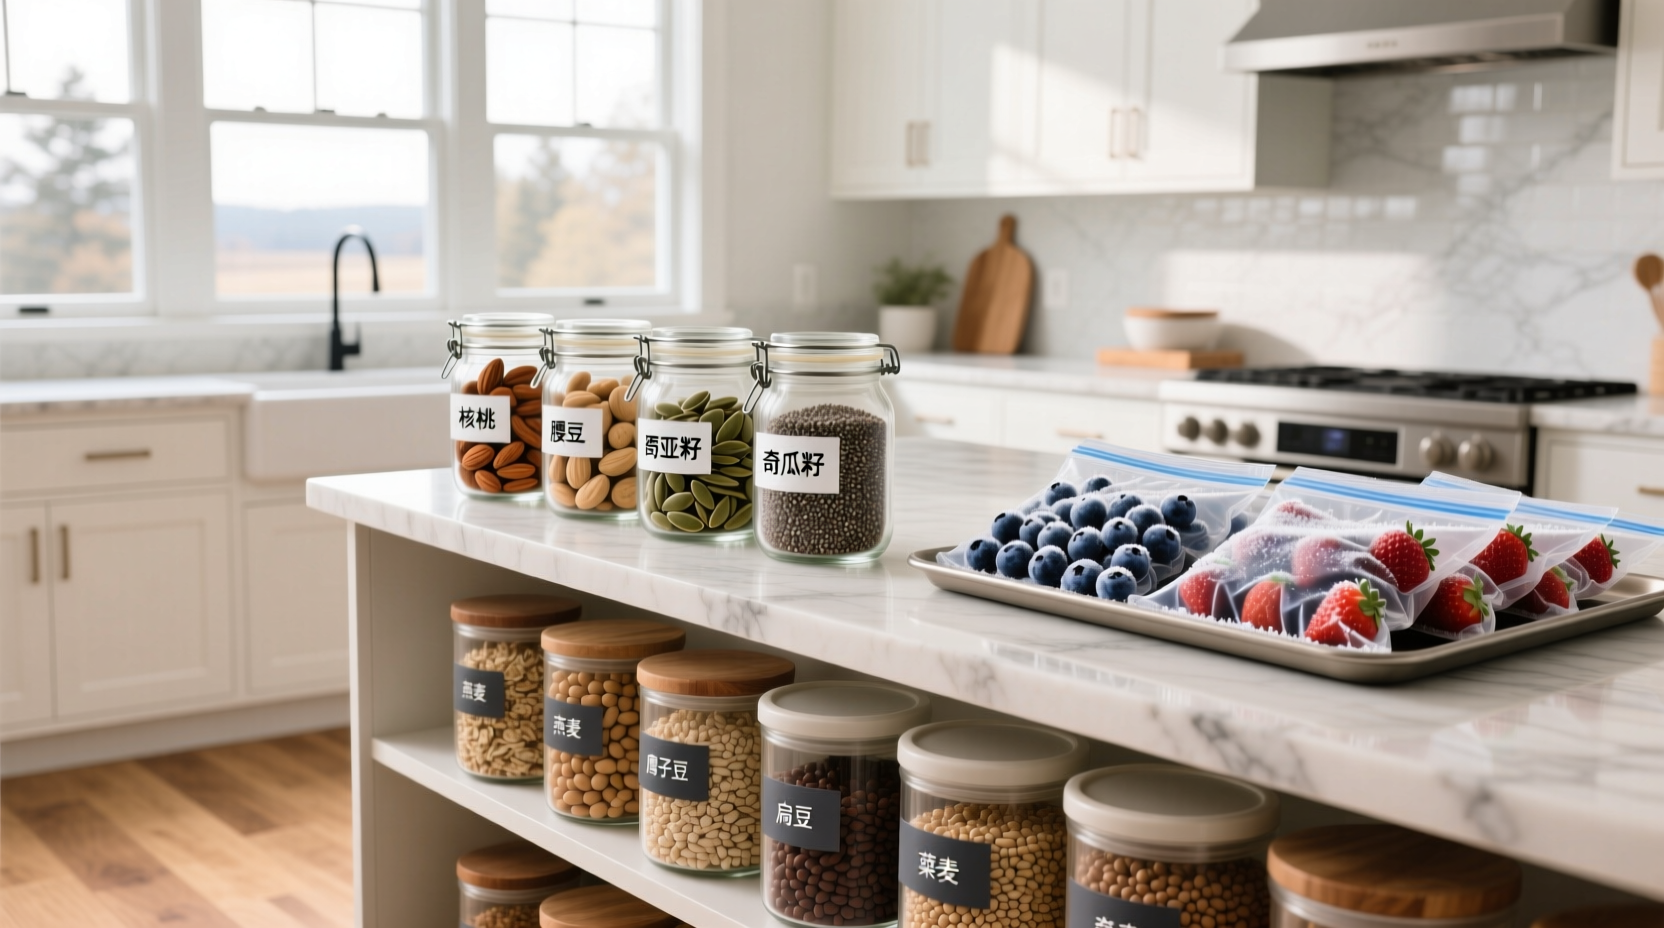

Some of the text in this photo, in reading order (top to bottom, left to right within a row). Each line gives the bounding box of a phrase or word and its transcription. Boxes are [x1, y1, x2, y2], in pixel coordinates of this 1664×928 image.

[458, 405, 496, 430] 核桃
[762, 449, 825, 478] 奇瓜籽
